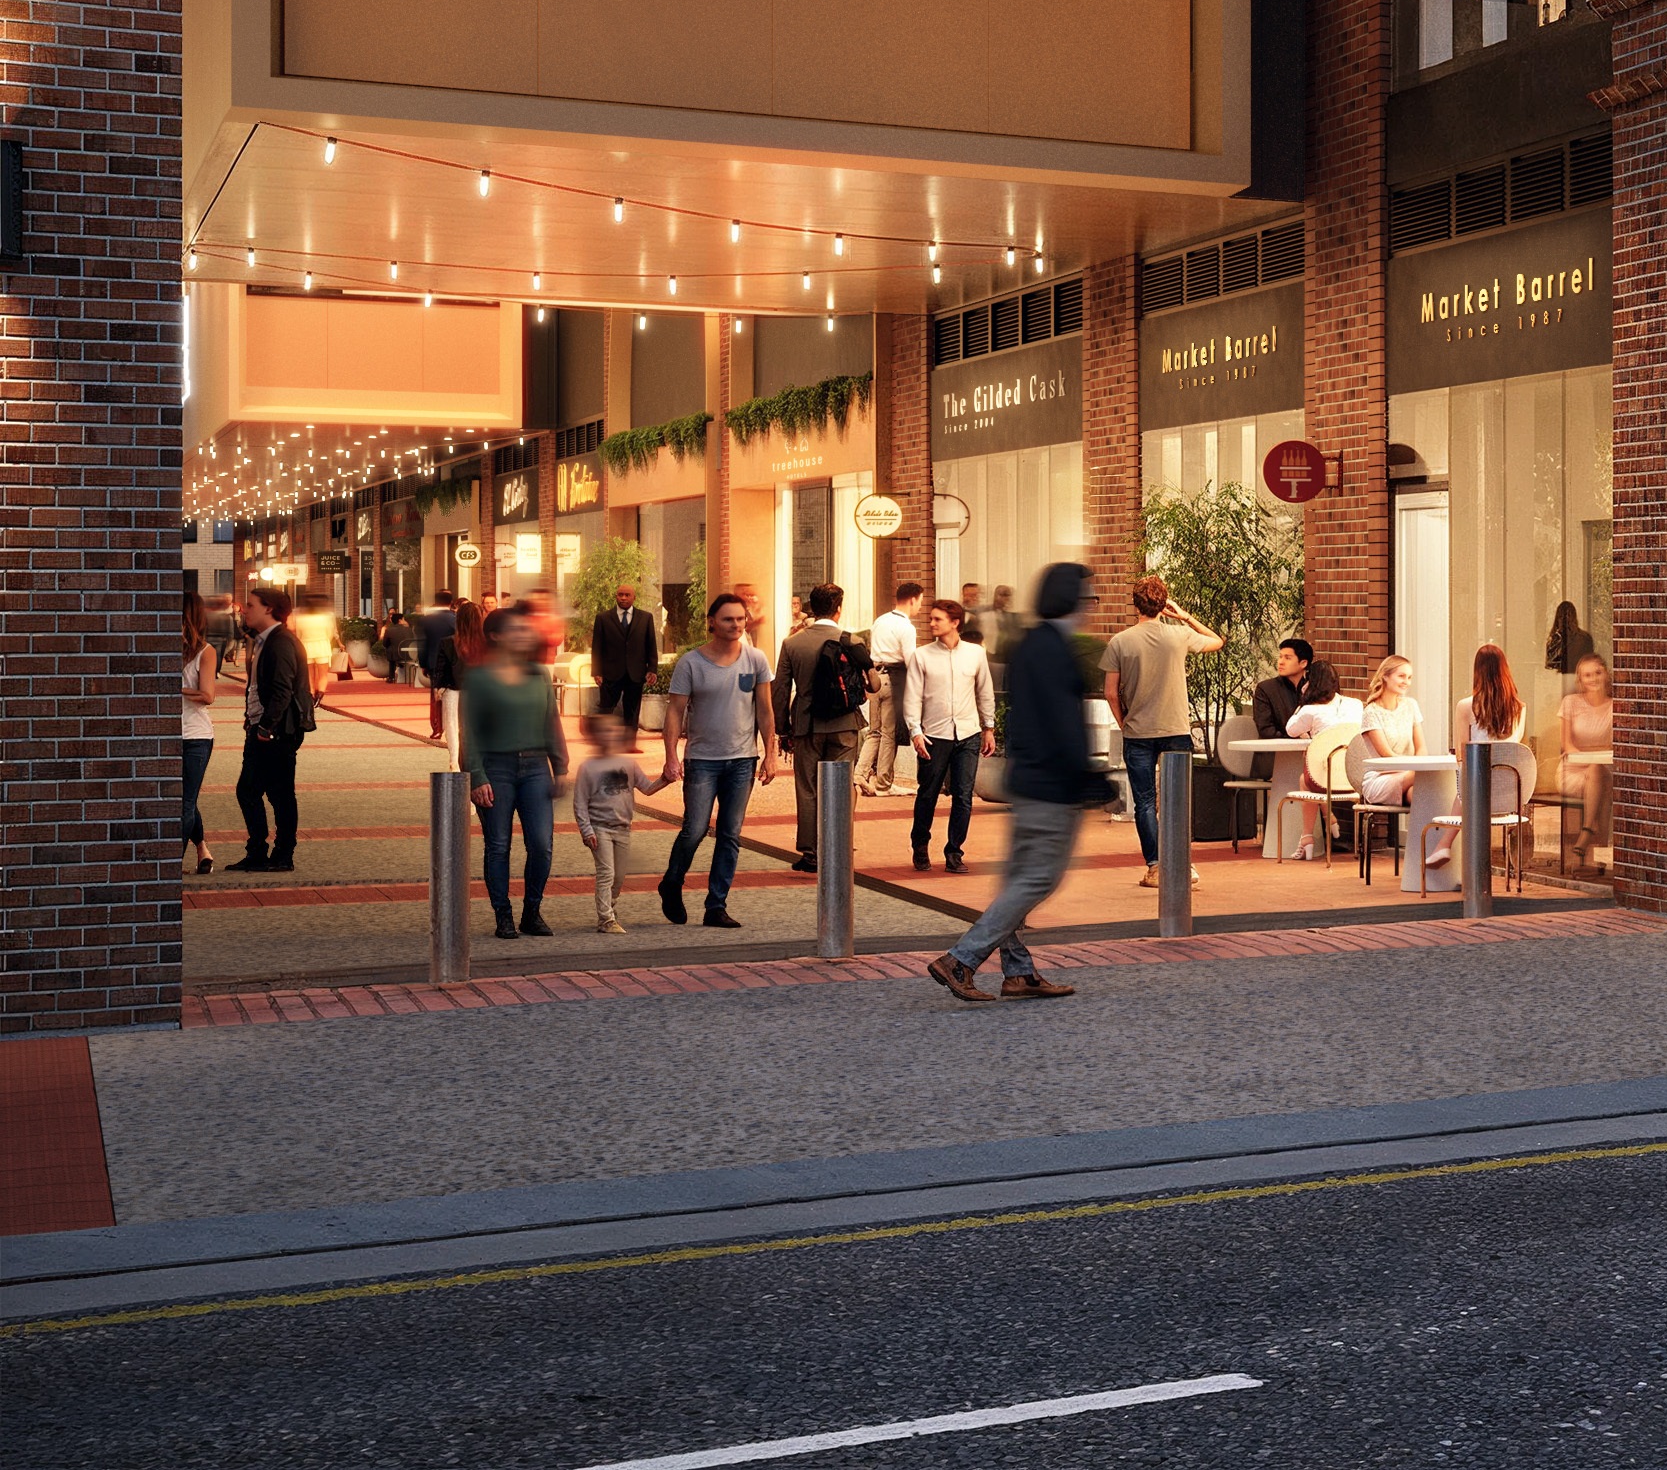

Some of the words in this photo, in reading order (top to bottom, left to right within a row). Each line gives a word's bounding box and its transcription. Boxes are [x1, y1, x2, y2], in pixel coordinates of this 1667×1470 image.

[1421, 278, 1500, 323] Market
[1516, 257, 1594, 305] Barrel
[1446, 322, 1499, 342] Since
[1518, 308, 1563, 329] 1987
[1162, 338, 1216, 374] Market
[1225, 325, 1277, 362] Barrel
[943, 393, 967, 419] The
[973, 378, 1021, 413] Gilded
[1029, 369, 1066, 403] Cask
[1179, 376, 1215, 390] Since
[772, 456, 823, 472] treehouse
